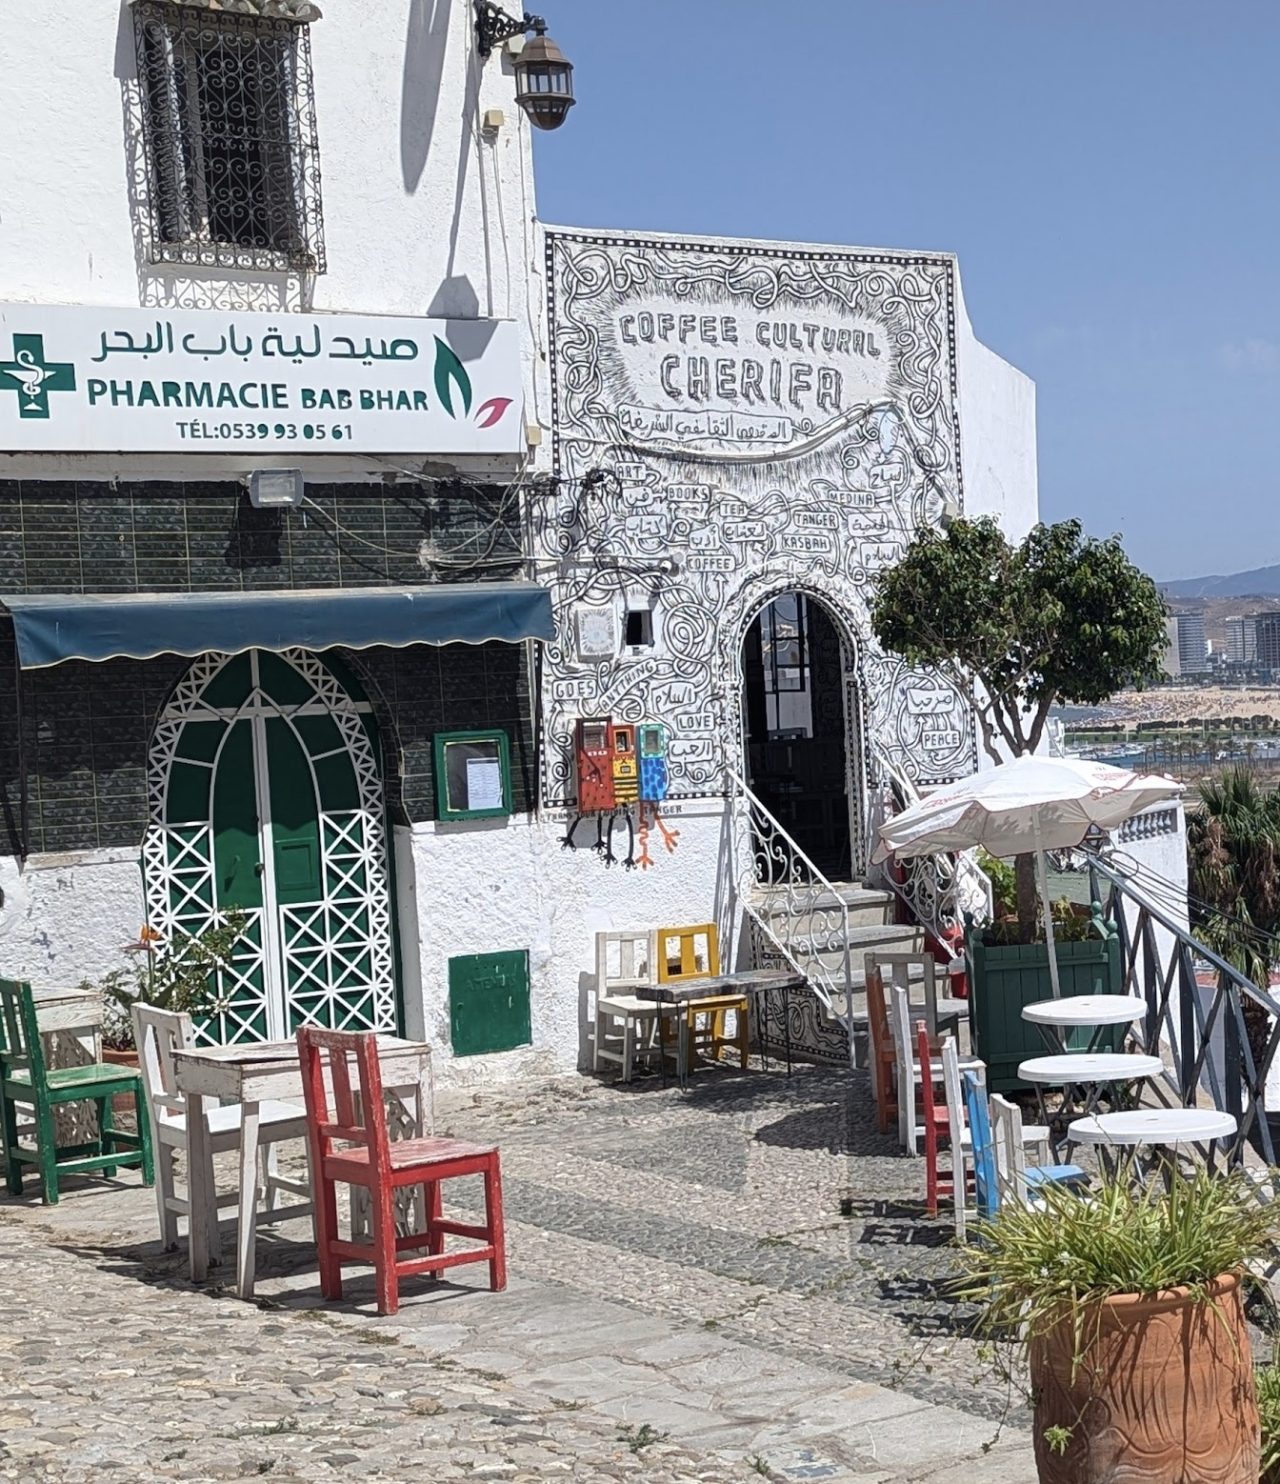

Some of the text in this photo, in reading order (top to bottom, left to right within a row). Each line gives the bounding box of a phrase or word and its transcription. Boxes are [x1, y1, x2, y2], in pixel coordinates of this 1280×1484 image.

[619, 311, 881, 357] COFFEE CULTURAL
[91, 321, 419, 366] صيدلية باب البحر
[660, 353, 842, 408] CHERIFA
[87, 378, 430, 412] PHARMACIE BAB BHAR
[274, 423, 298, 440] 93
[303, 424, 326, 440] 05
[331, 424, 353, 440] 61
[616, 465, 641, 479] ART
[669, 486, 708, 500] BOOKS
[829, 491, 873, 506] MEDINA
[724, 503, 745, 514] TEA
[795, 513, 836, 528] TANGER
[784, 535, 827, 549] KASBAH
[687, 558, 730, 570] COFFEE
[556, 680, 595, 698] GOES
[602, 660, 656, 709] ANYTHING
[679, 714, 711, 729] LOVE
[924, 733, 958, 747] PEACE
